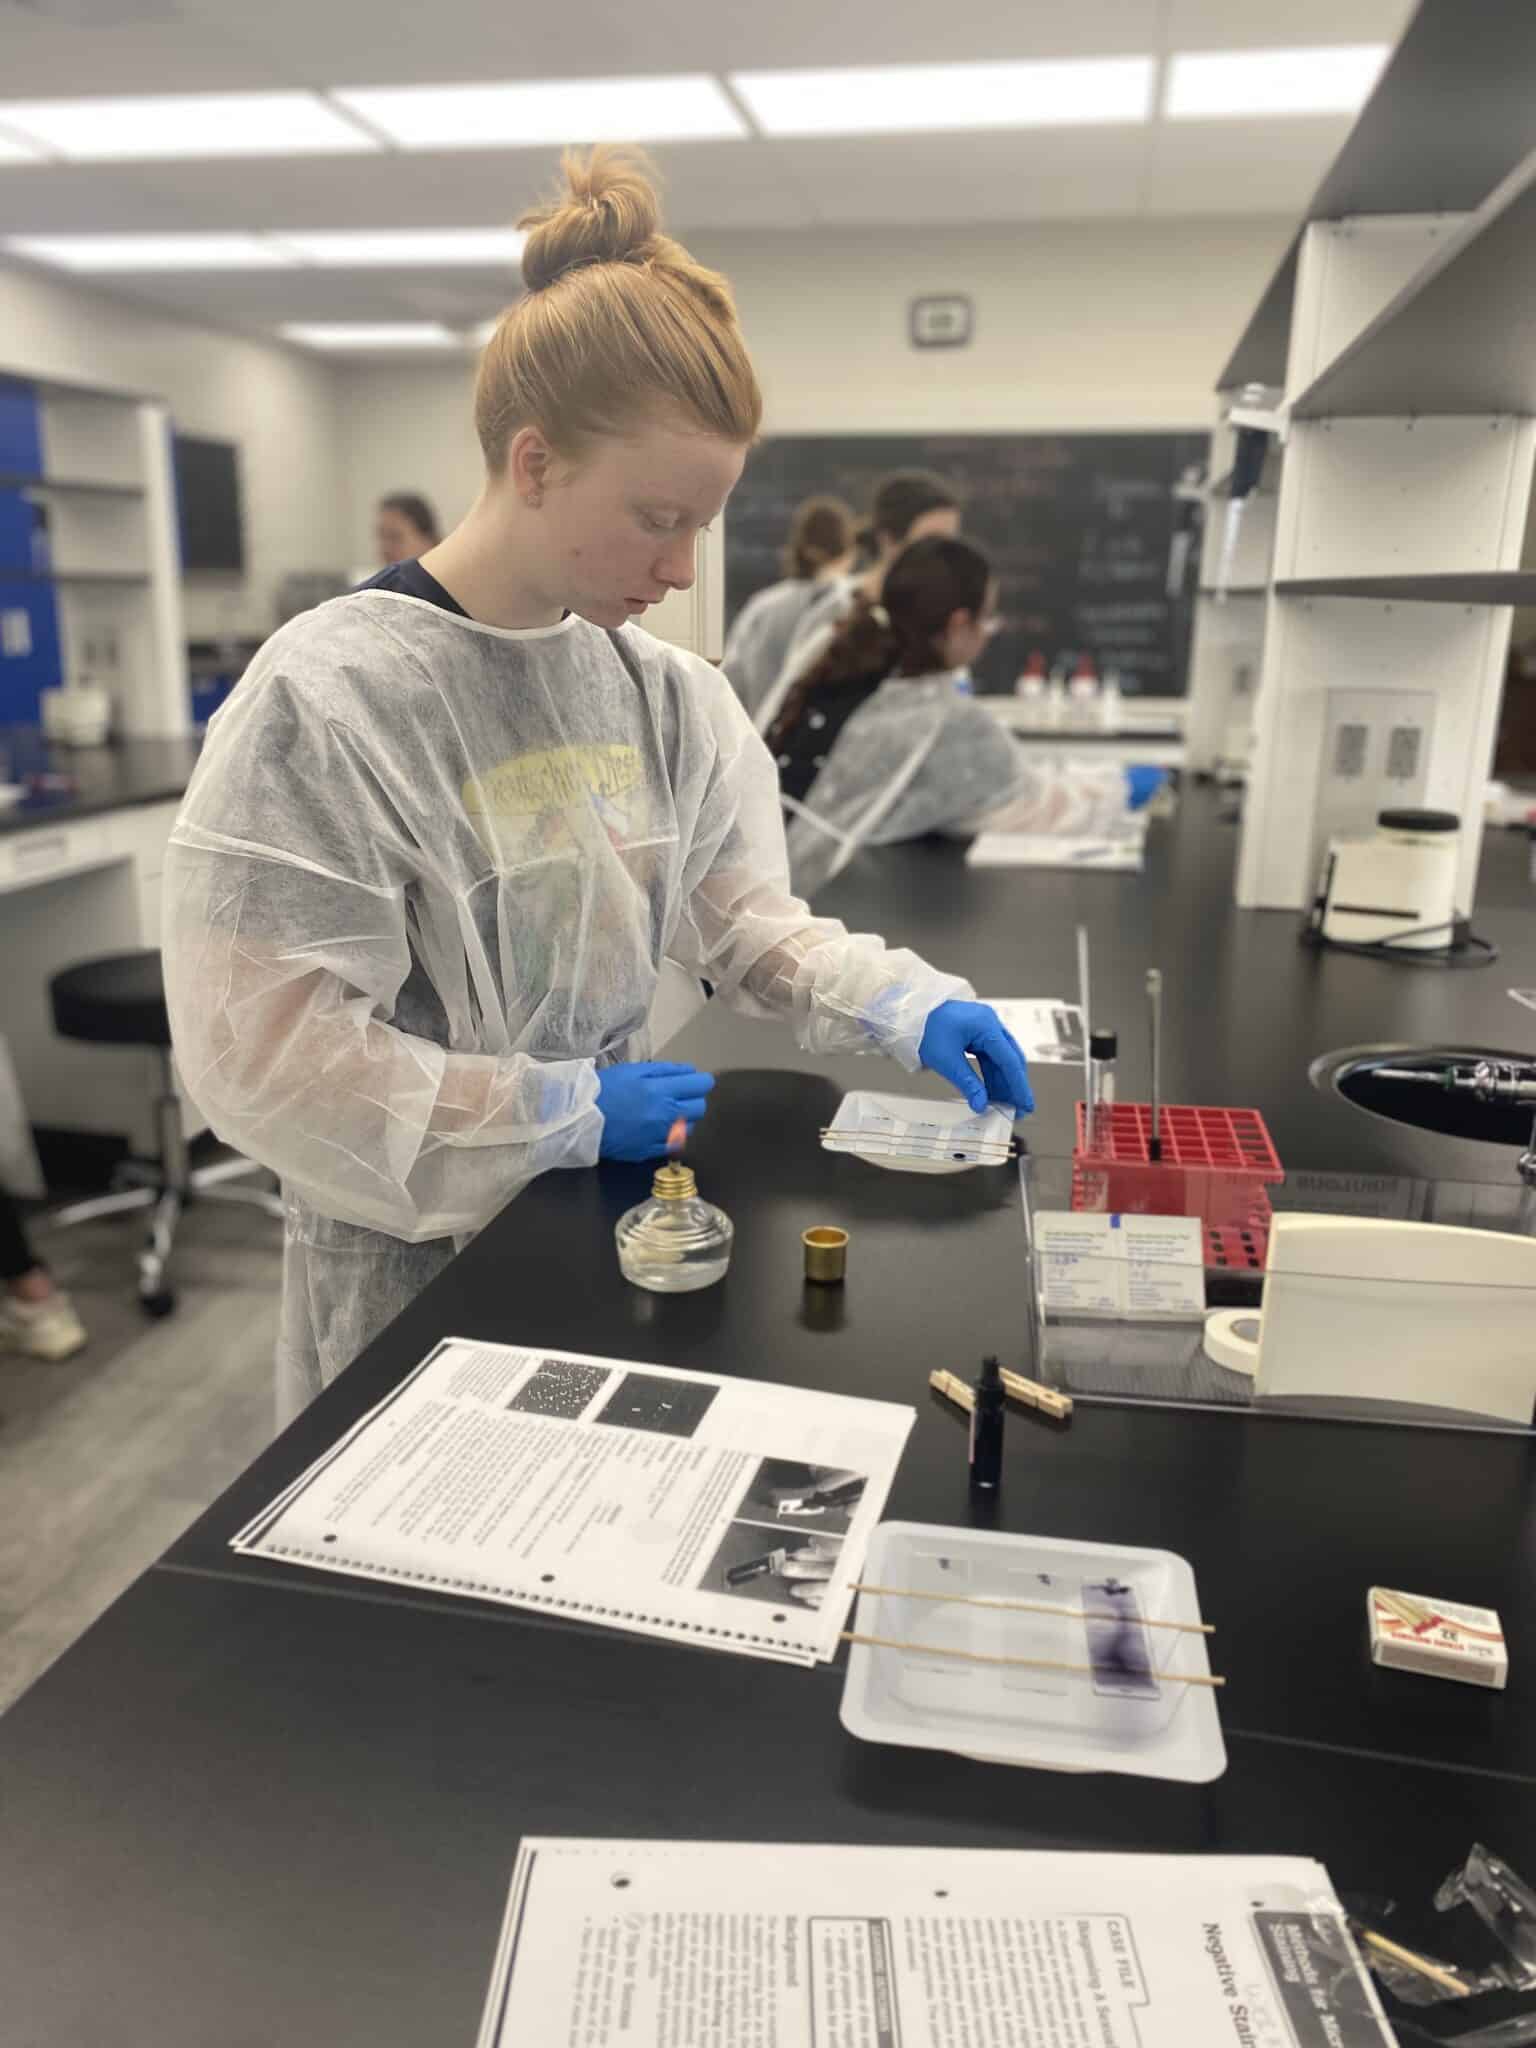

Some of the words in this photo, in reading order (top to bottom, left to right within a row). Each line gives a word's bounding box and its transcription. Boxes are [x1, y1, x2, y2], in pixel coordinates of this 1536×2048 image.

[1107, 1920, 1126, 1952] CASE
[1202, 1922, 1239, 1998] Negative
[1269, 1923, 1300, 1982] Staining
[1116, 1959, 1136, 1989] FILE
[1286, 1924, 1319, 1984] Methods
[1309, 1988, 1328, 2010] for
